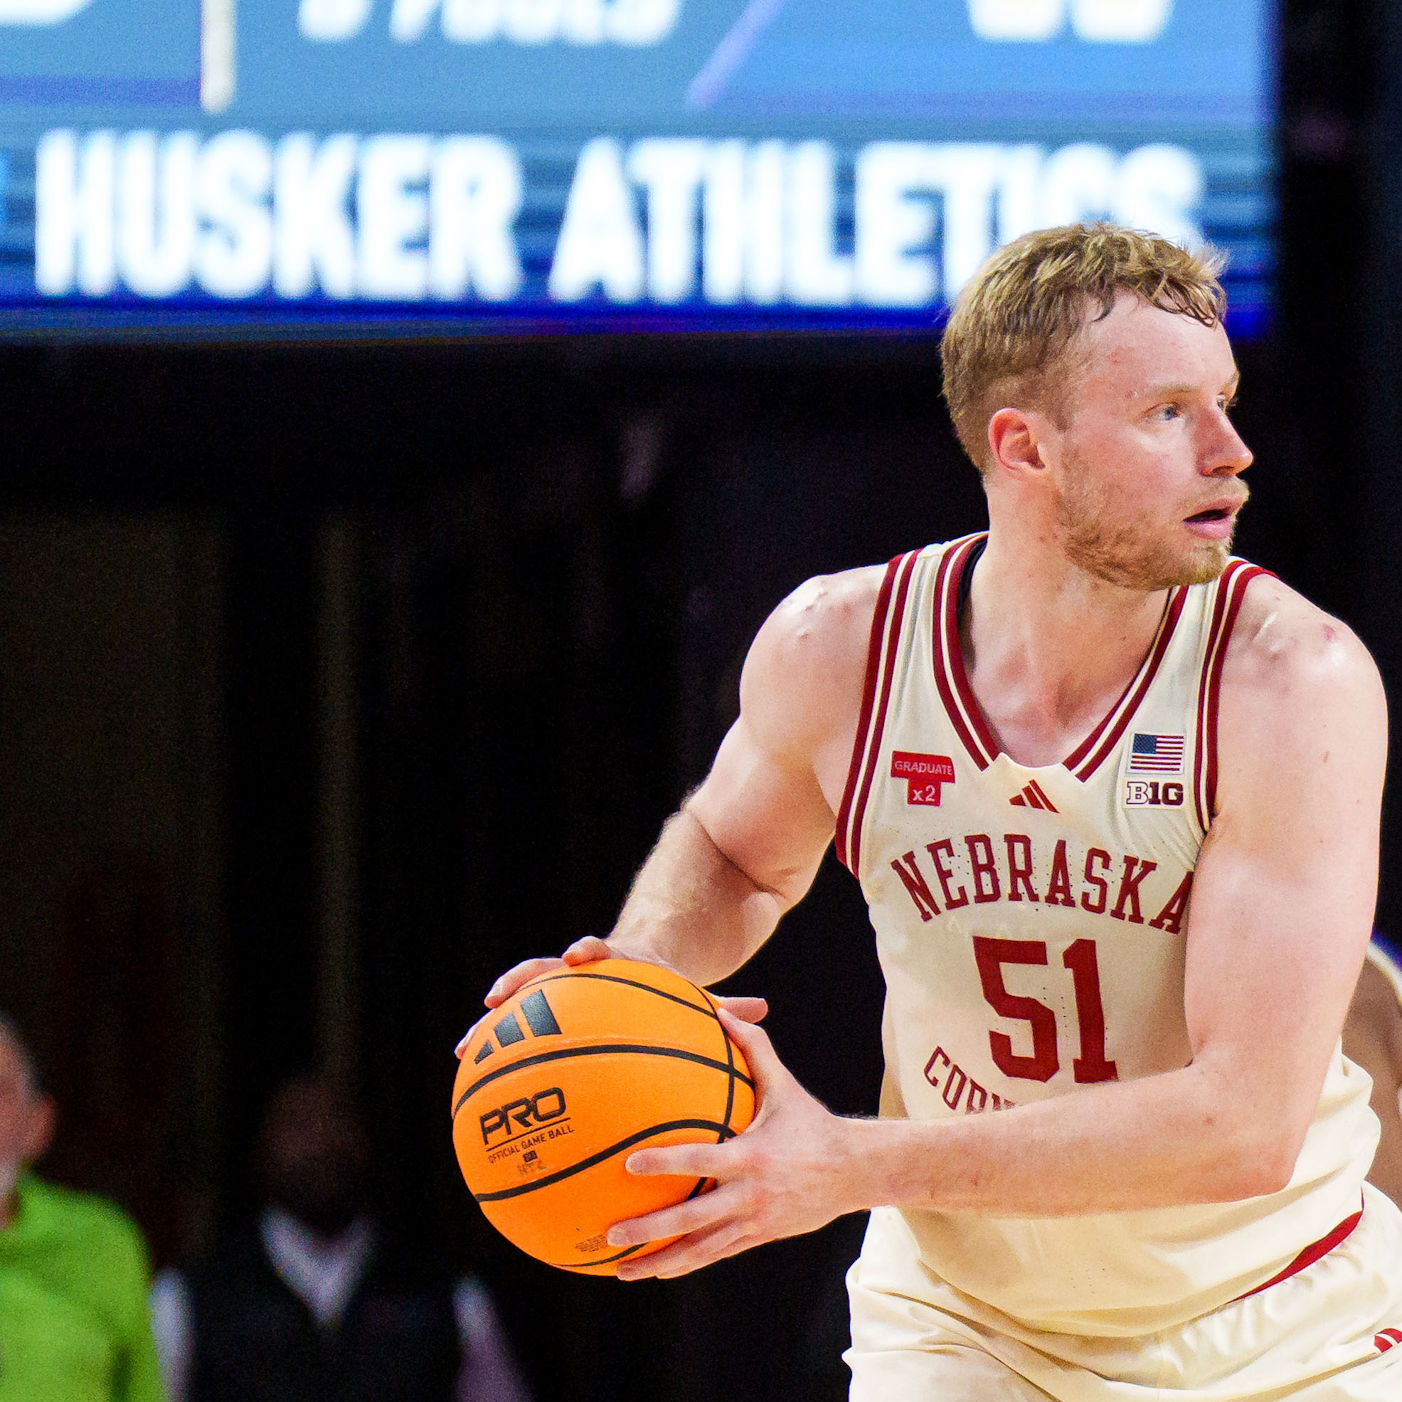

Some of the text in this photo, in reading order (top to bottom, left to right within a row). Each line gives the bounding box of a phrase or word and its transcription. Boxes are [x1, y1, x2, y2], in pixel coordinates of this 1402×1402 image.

[34, 127, 524, 301] HUSKER
[894, 761, 953, 775] GRADUATE
[890, 833, 1194, 934] NEBRASKA
[972, 935, 1119, 1083] 51
[480, 1087, 566, 1145] PRO
[521, 1133, 546, 1149] GAME
[547, 1125, 575, 1139] BALL
